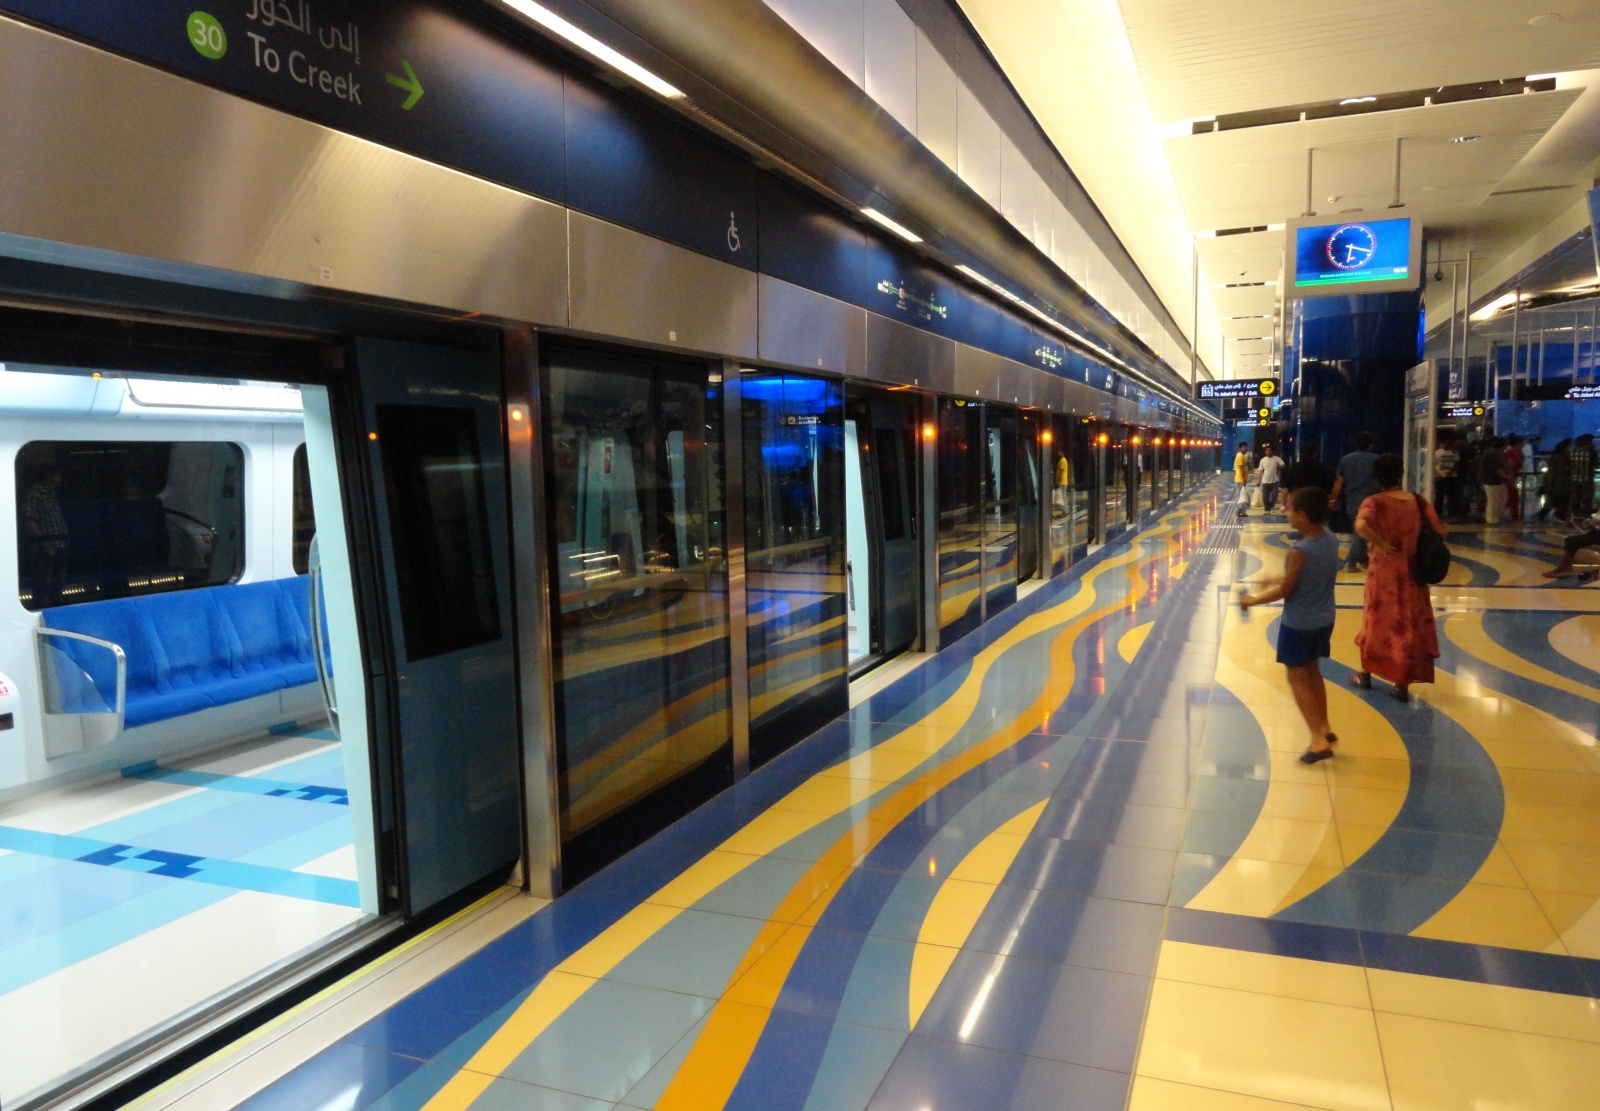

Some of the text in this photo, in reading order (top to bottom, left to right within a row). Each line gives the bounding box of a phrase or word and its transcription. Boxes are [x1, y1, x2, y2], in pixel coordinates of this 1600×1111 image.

[194, 19, 223, 51] 30
[318, 22, 361, 65] إلى
[246, 31, 362, 105] To Creek
